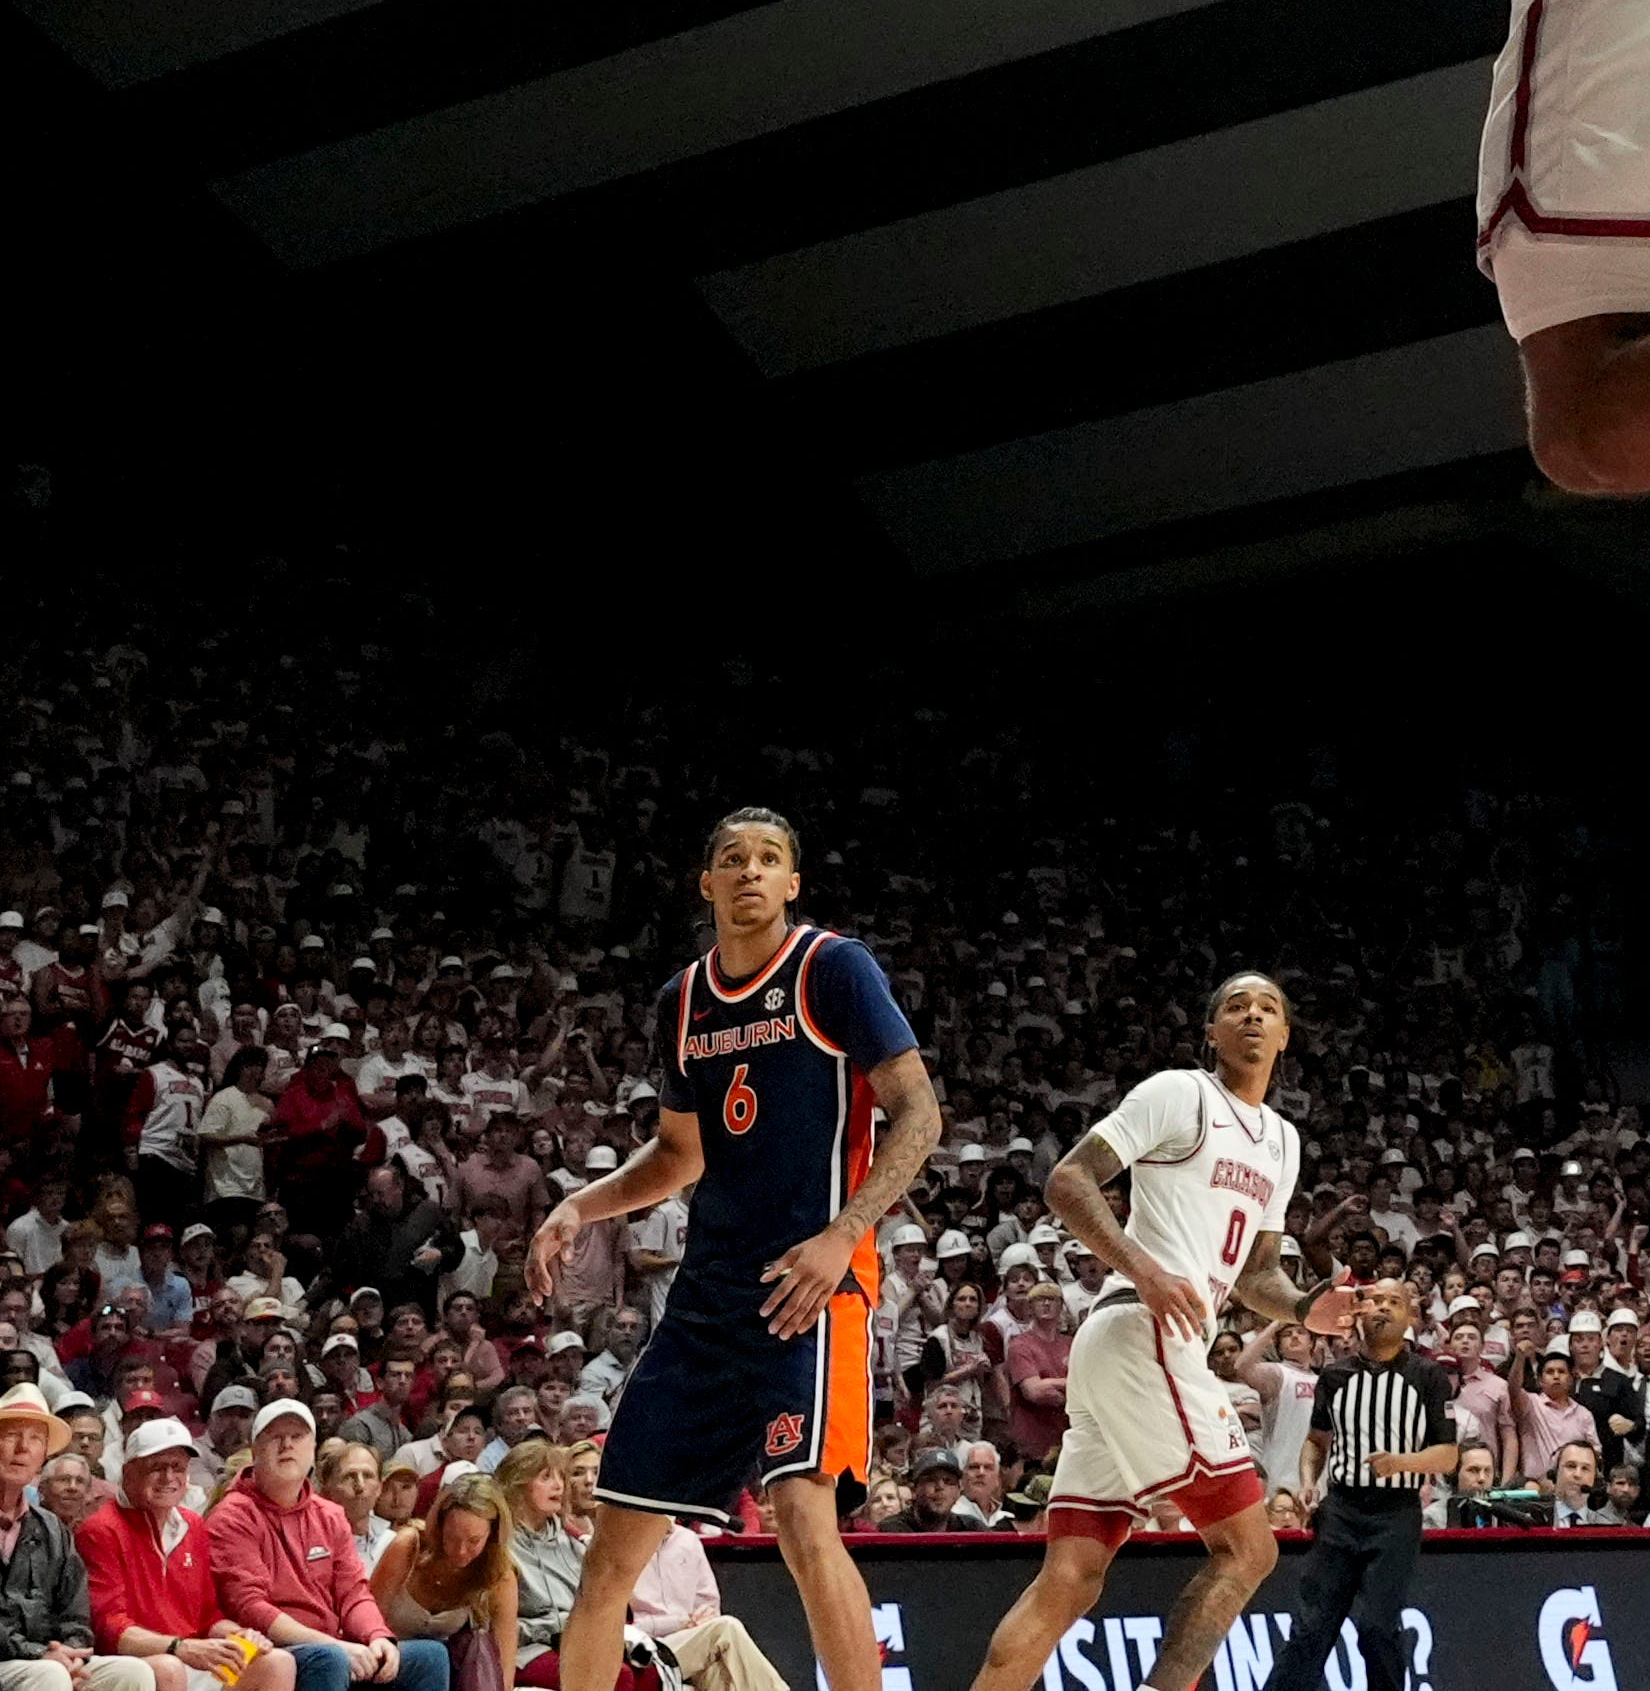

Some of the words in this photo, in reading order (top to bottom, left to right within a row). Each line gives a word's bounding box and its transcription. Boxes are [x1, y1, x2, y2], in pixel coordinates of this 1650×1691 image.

[683, 1014, 796, 1061] AUBURN
[723, 1063, 758, 1136] 6
[1220, 1206, 1247, 1267] 0
